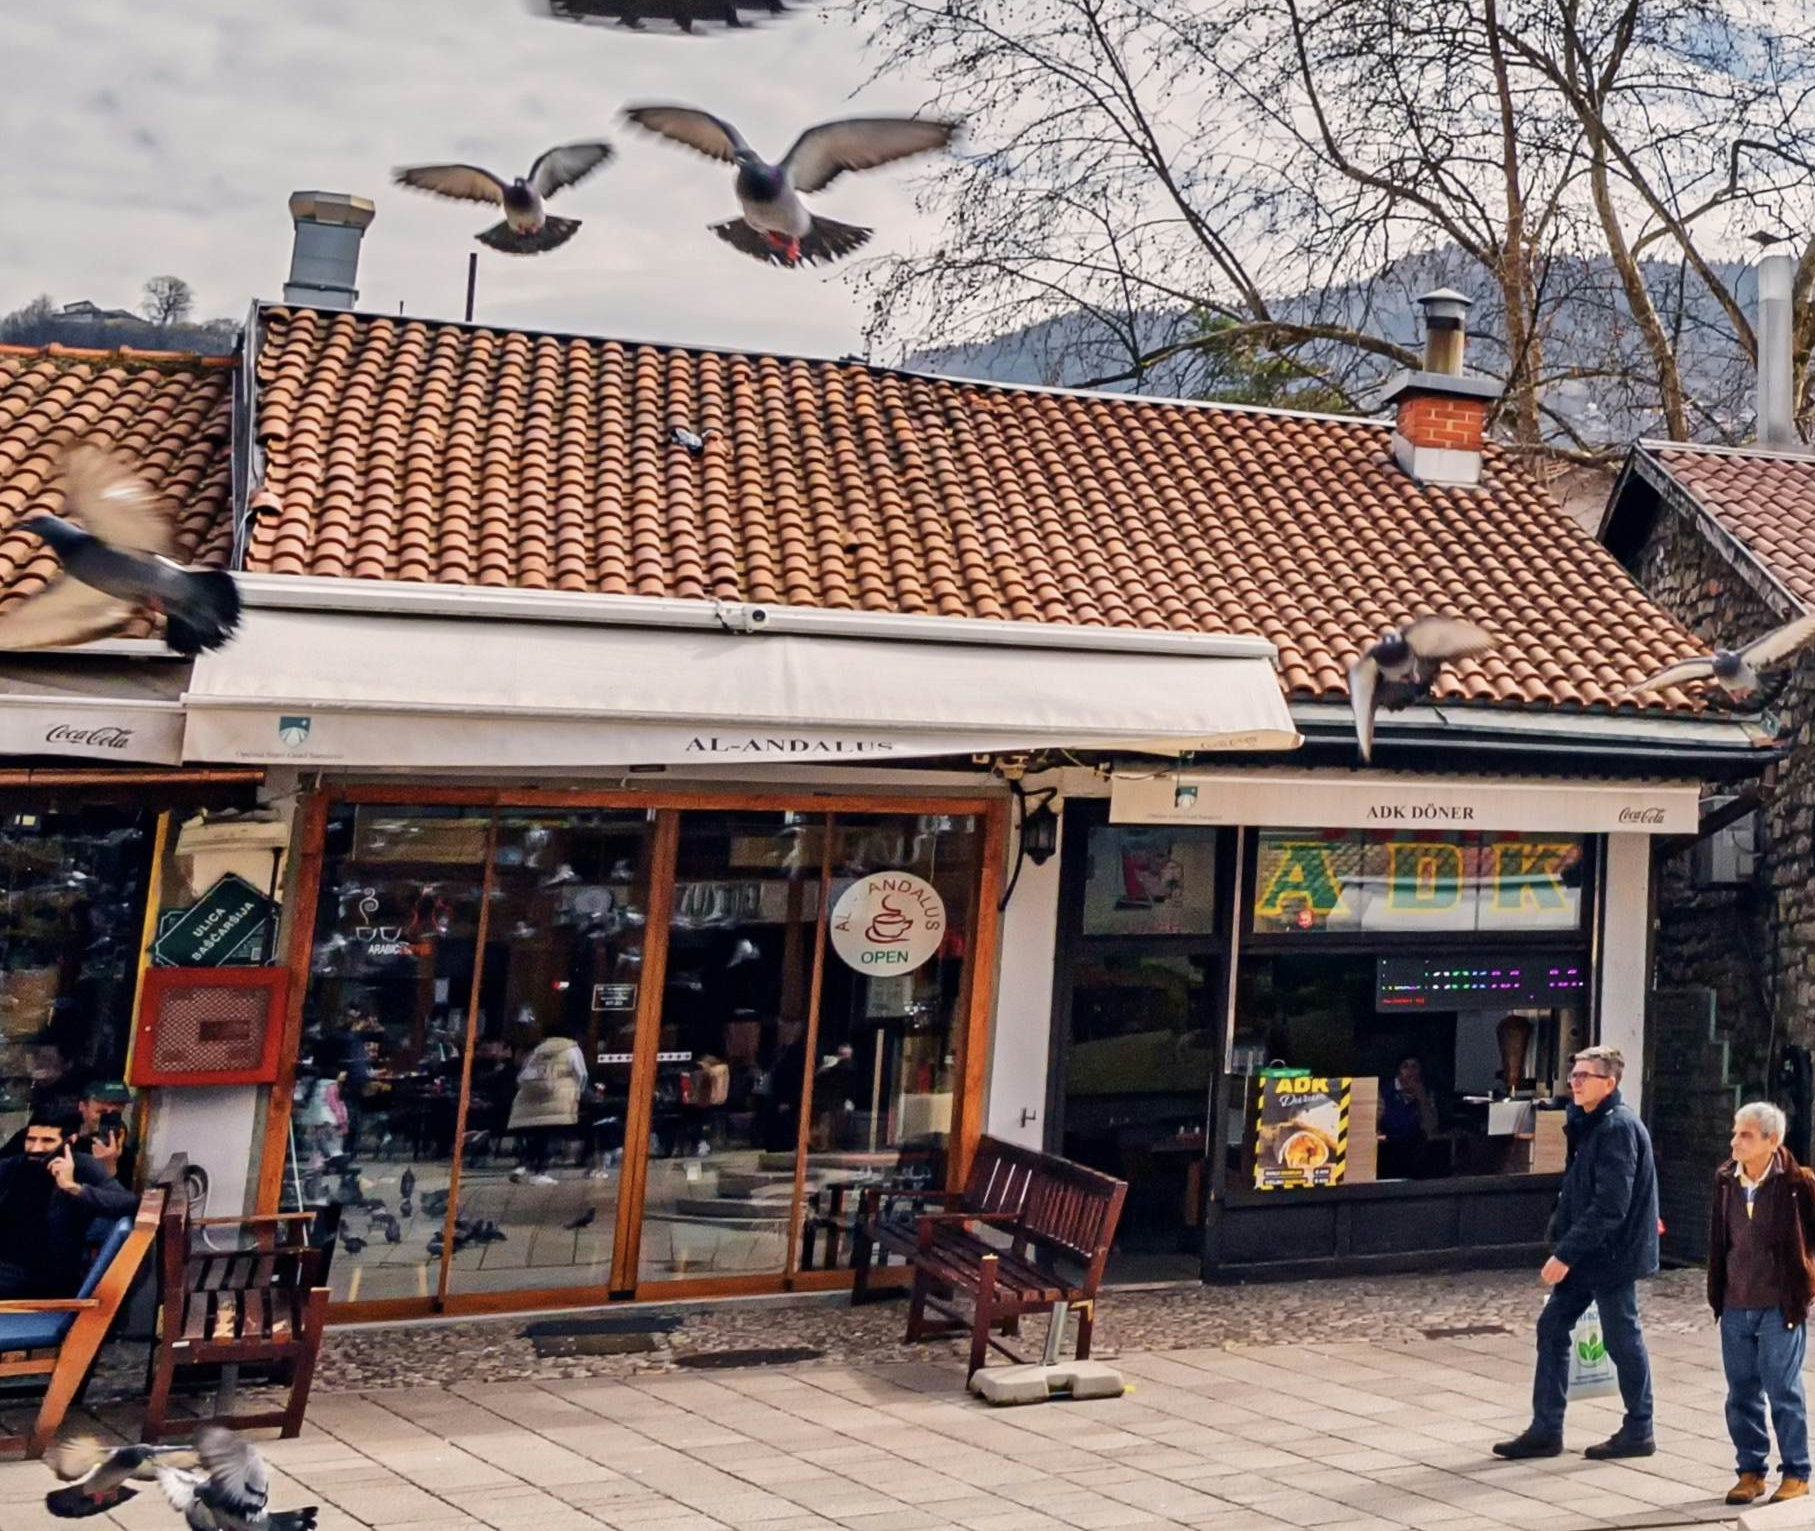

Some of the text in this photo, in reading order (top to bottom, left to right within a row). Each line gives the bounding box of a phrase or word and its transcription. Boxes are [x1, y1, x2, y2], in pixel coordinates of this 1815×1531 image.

[685, 736, 894, 752] AL-ANDALUS
[1366, 803, 1475, 819] ADK DÖNER
[1253, 841, 1577, 917] ADK
[867, 879, 940, 931] ANDALUS
[192, 908, 226, 937] ULICA
[861, 951, 909, 964] OPEN
[1275, 1077, 1330, 1094] ADK
